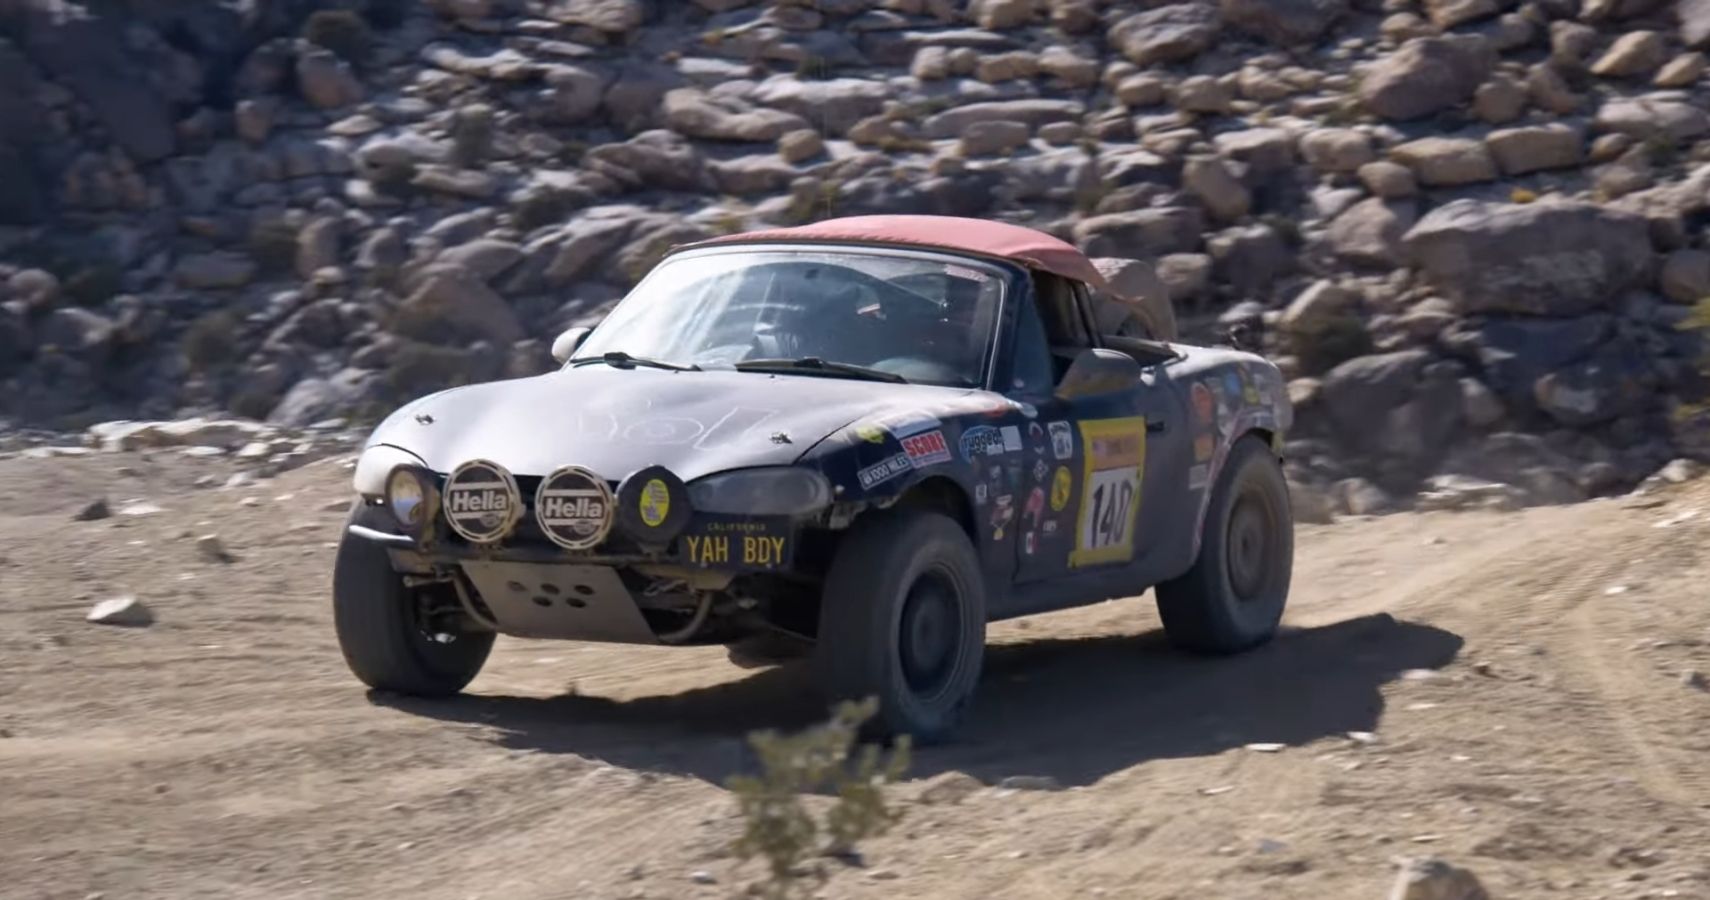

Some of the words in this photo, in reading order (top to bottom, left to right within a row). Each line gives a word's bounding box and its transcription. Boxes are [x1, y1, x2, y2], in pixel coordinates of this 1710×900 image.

[903, 431, 946, 457] SCORE
[452, 490, 507, 512] Hella
[545, 497, 602, 519] Hella
[1091, 480, 1133, 548] 140
[706, 522, 767, 532] CALIFORNIA
[687, 535, 729, 564] YAH
[743, 535, 786, 565] BDY
